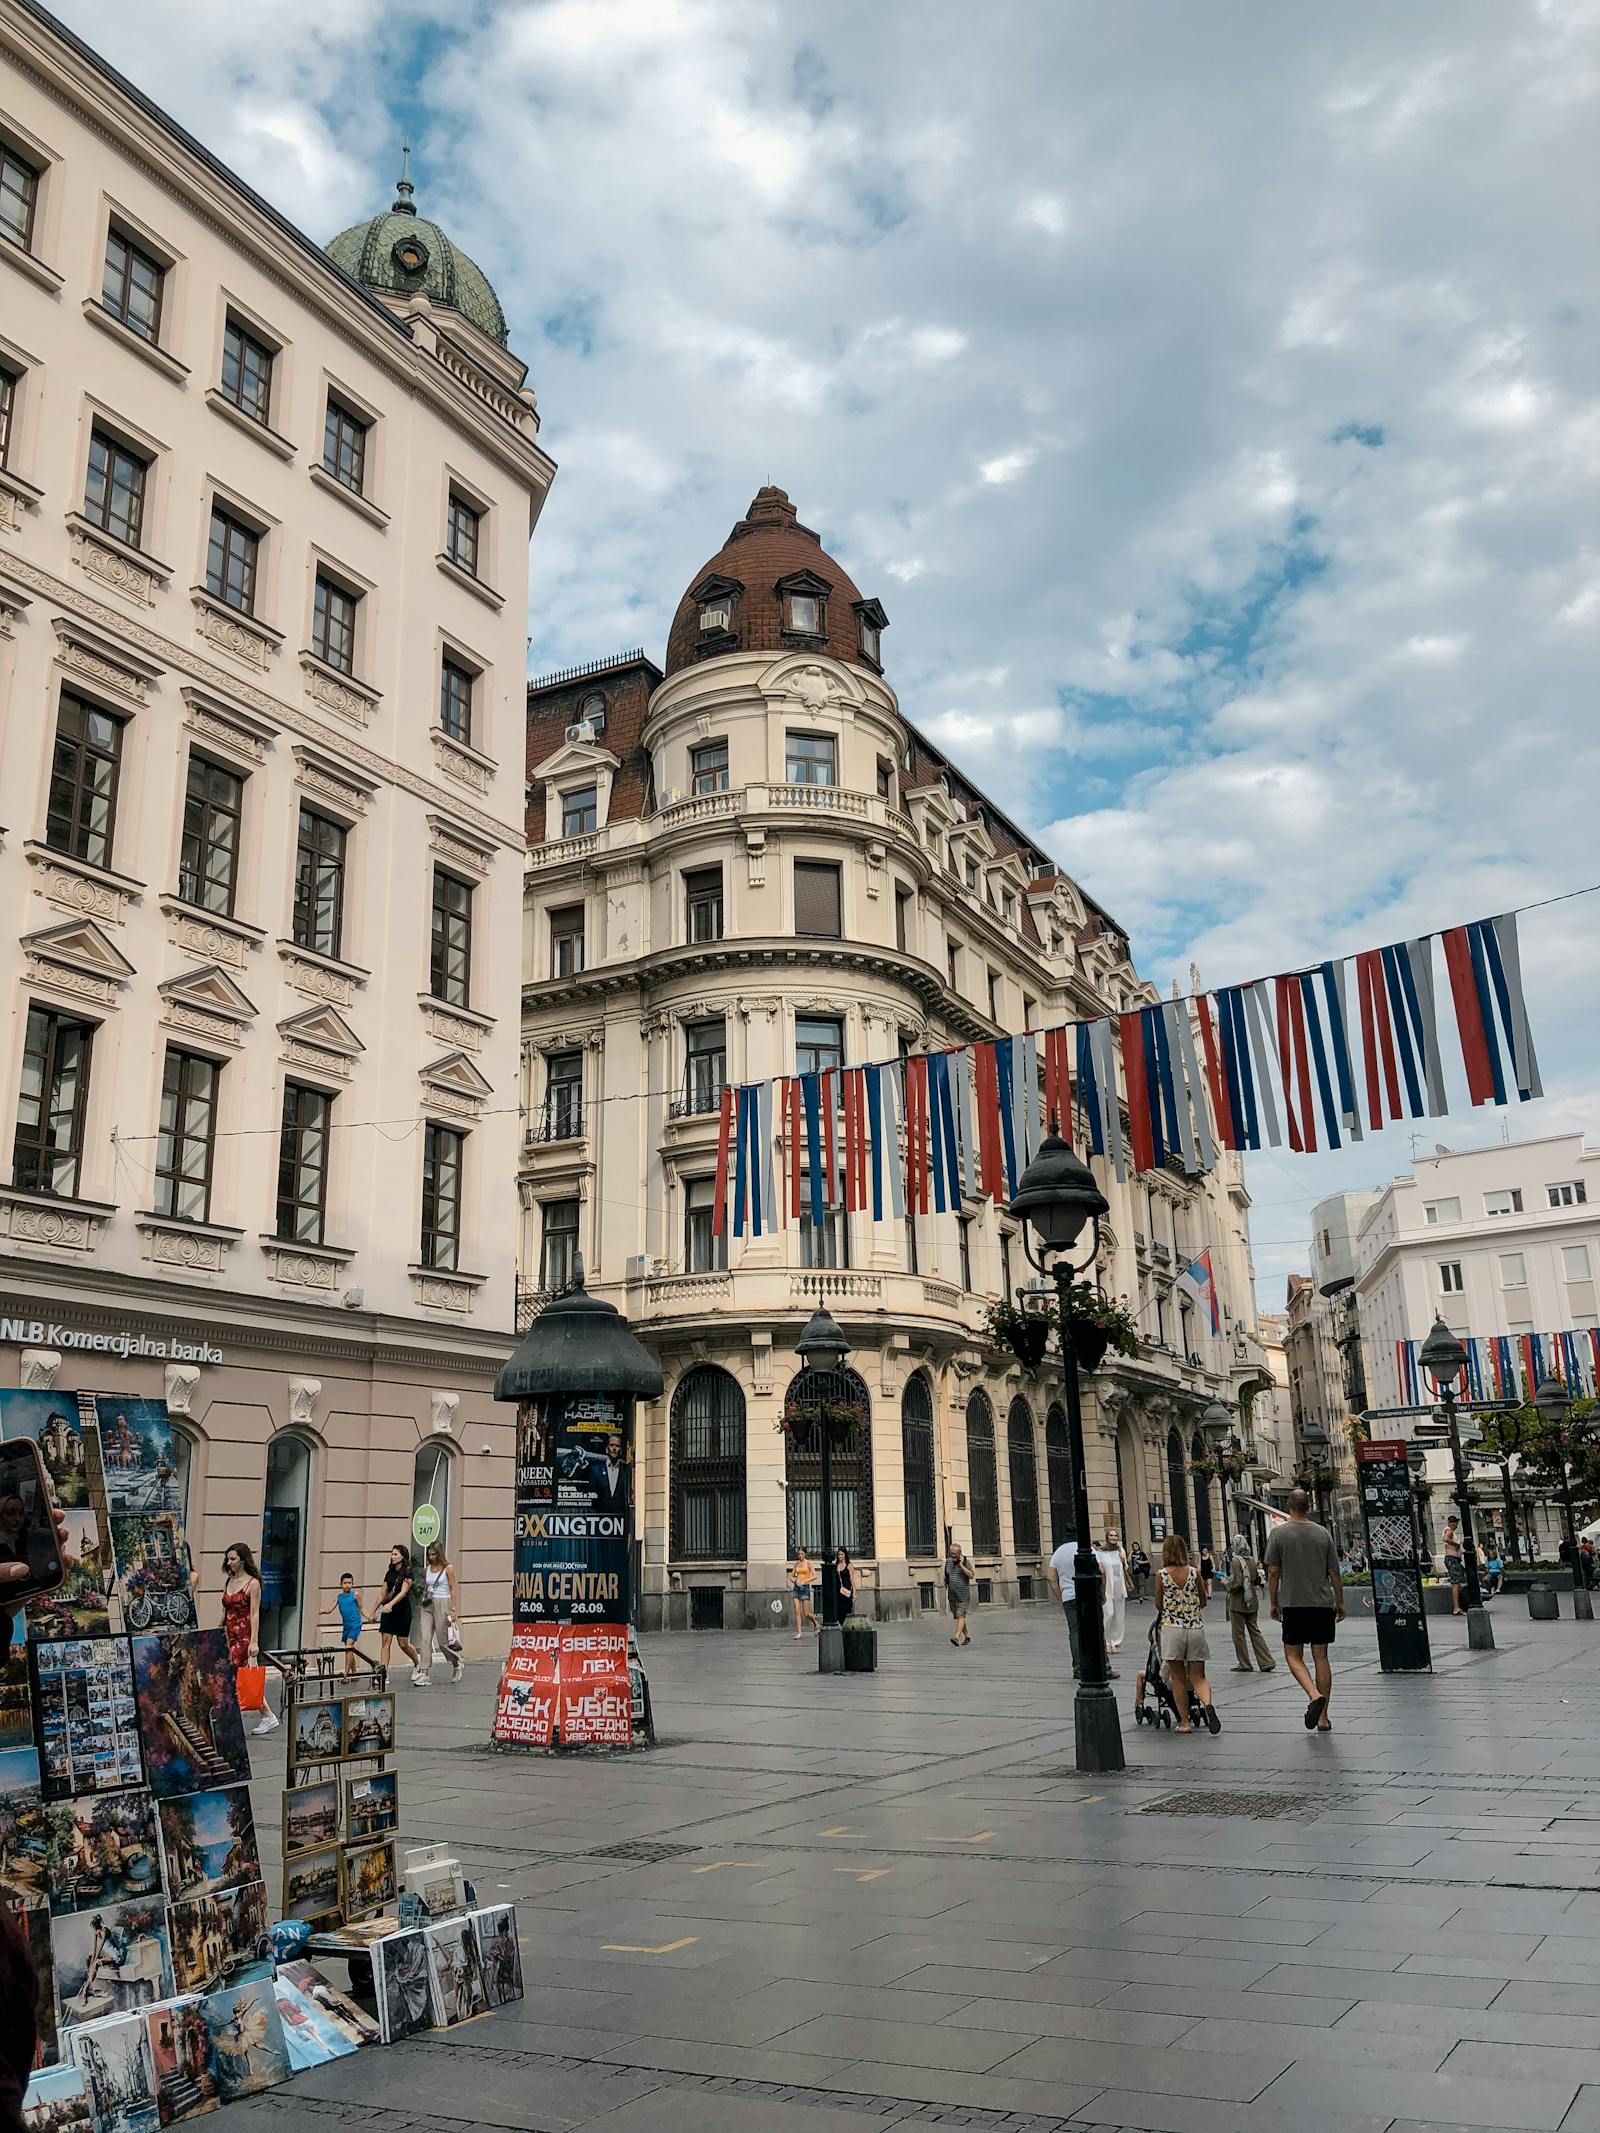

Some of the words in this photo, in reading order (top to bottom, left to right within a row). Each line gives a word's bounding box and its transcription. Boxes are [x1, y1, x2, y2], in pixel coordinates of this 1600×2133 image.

[0, 1318, 45, 1343] NLB
[47, 1324, 166, 1359] Komercijalna
[170, 1338, 223, 1364] banka
[578, 1403, 615, 1412] CHRIS
[564, 1411, 624, 1421] HADFIELD
[517, 1467, 554, 1487] QUEEN
[417, 1515, 435, 1524] ZONA
[419, 1527, 433, 1536] 24/7
[514, 1572, 545, 1600] SAVA
[548, 1573, 619, 1600] CENTAR
[519, 1601, 545, 1613] 25.09.
[553, 1604, 560, 1614] &
[570, 1602, 606, 1614] 26.09.
[562, 1636, 626, 1653] ЗВЕЗДА
[511, 1656, 539, 1673] ЛЕХ
[581, 1659, 616, 1675] ЛЕХ
[498, 1694, 552, 1719] УВЕК
[565, 1696, 628, 1717] УВЕК
[565, 1718, 629, 1732] ЗАЈЕДНО
[496, 1730, 510, 1738] ВЕК
[565, 1732, 591, 1741] УВЕК
